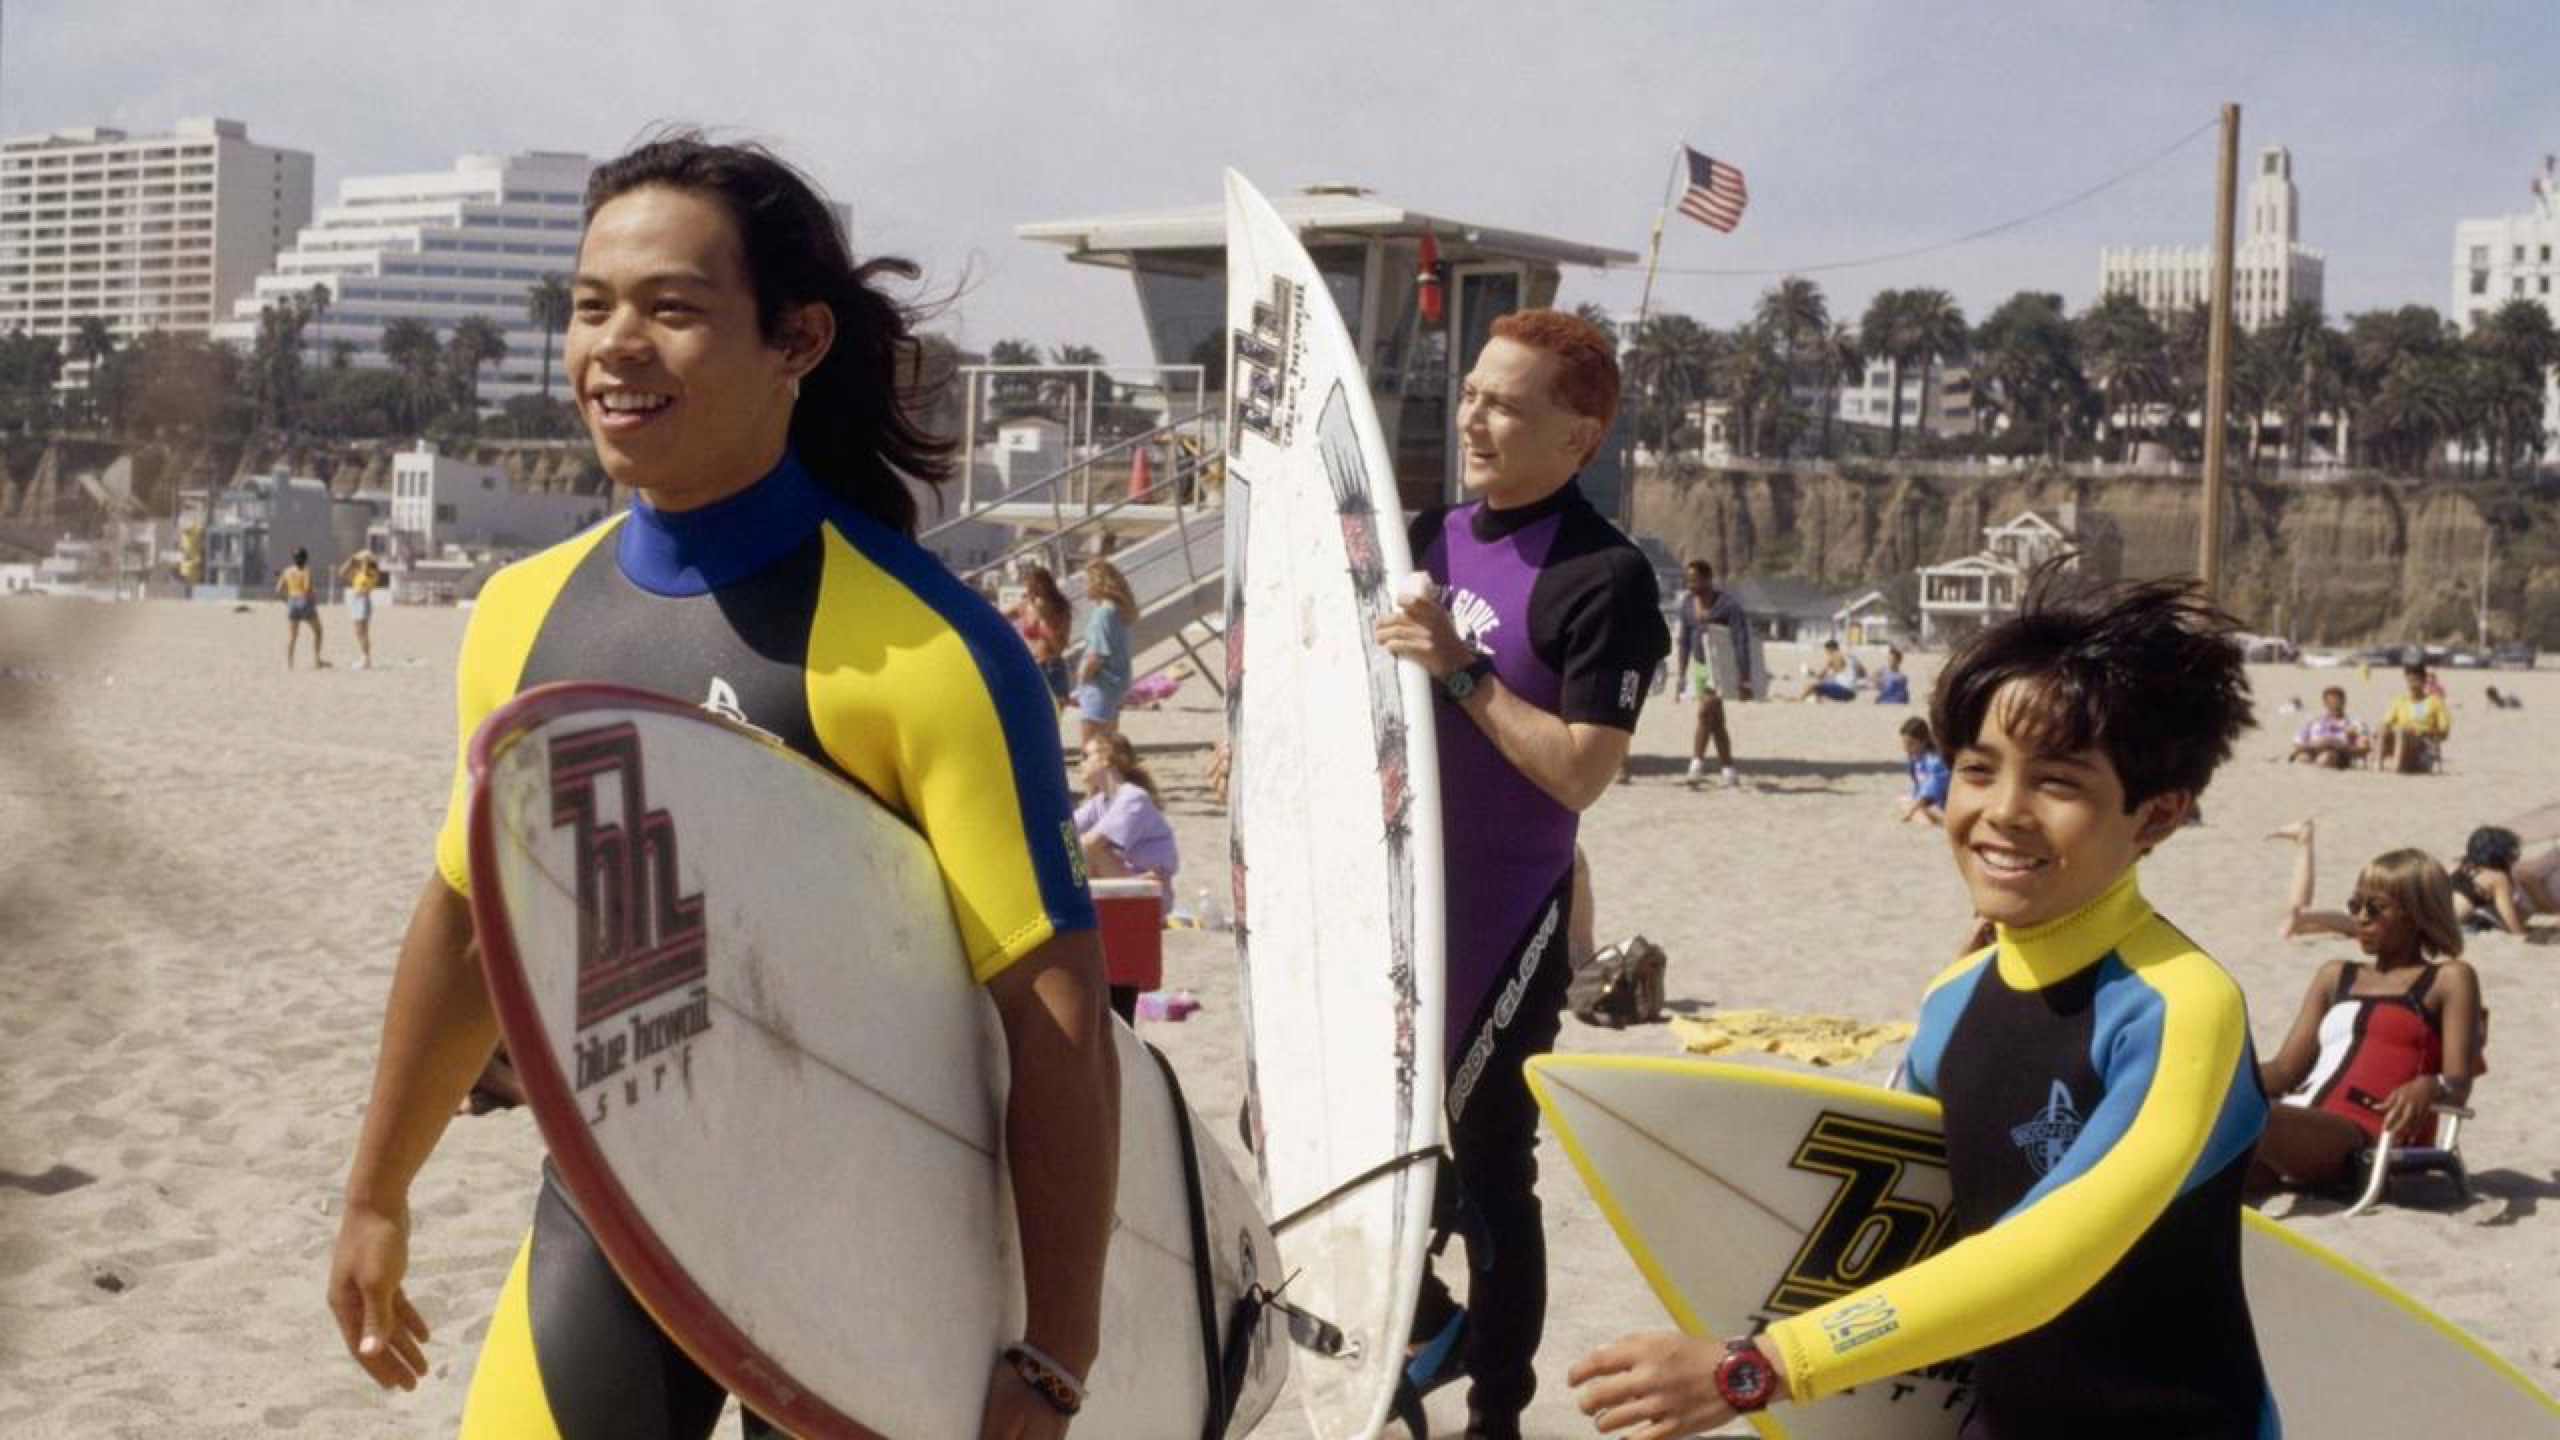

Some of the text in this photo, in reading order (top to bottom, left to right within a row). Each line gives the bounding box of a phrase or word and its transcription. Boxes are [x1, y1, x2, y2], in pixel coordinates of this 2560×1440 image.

[1448, 898, 1560, 1123] BODY GLOVE
[574, 1033, 627, 1092] blue
[590, 1044, 693, 1126] surf
